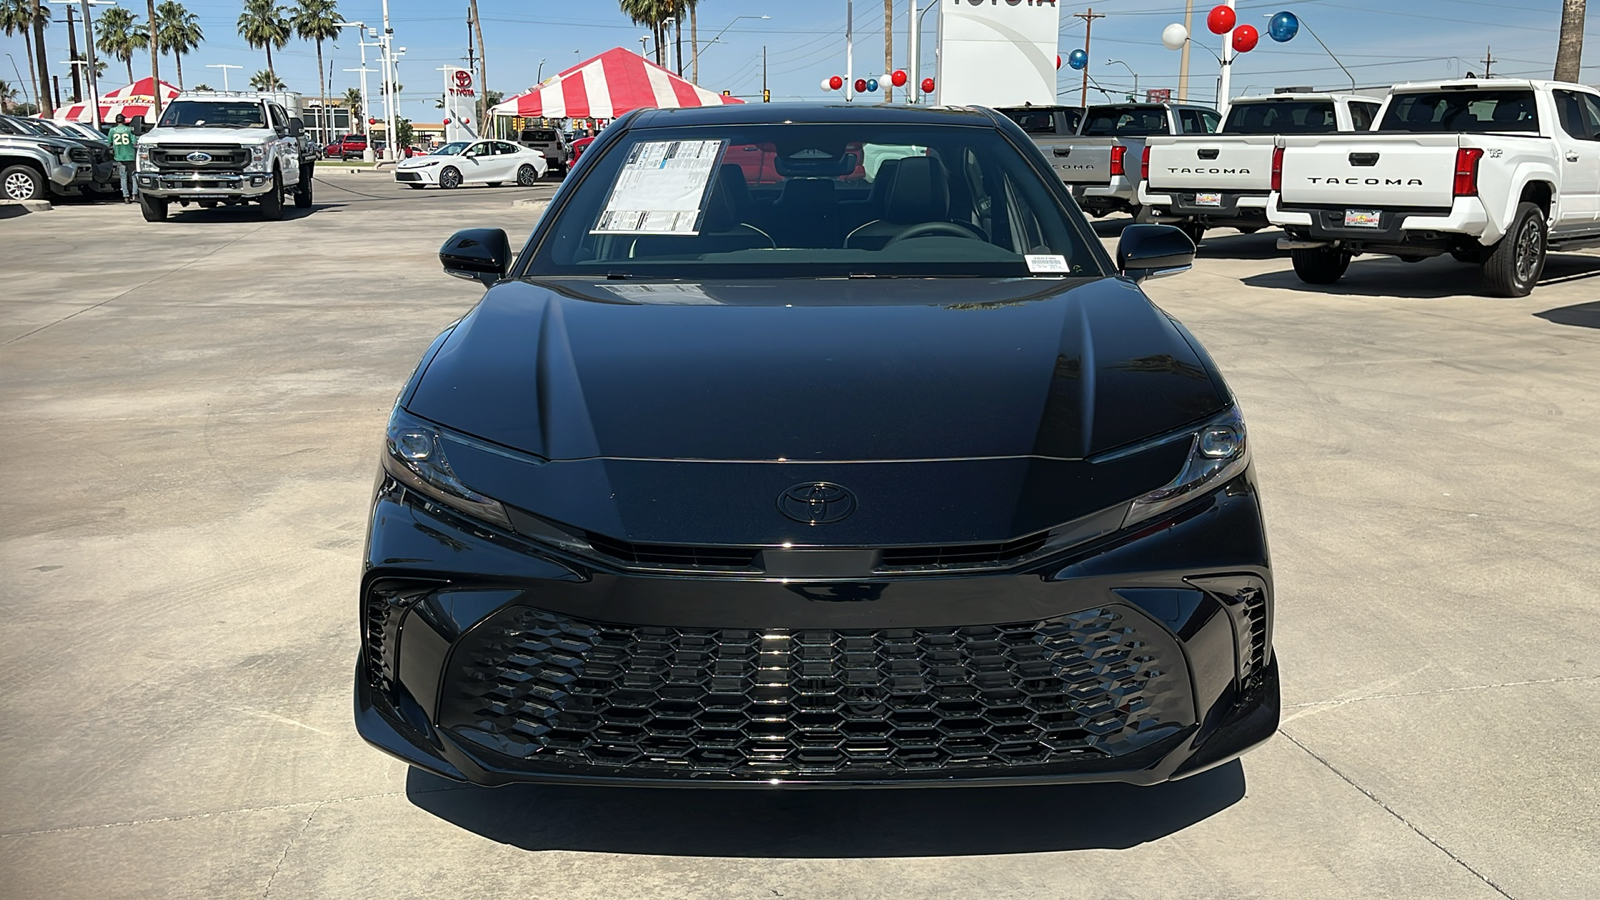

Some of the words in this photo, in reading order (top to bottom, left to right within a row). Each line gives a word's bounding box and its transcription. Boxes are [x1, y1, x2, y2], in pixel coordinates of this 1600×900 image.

[449, 88, 475, 97] TYOTA
[113, 133, 129, 145] 26
[1167, 167, 1251, 175] TACOMA
[1307, 177, 1423, 186] TACOMA
